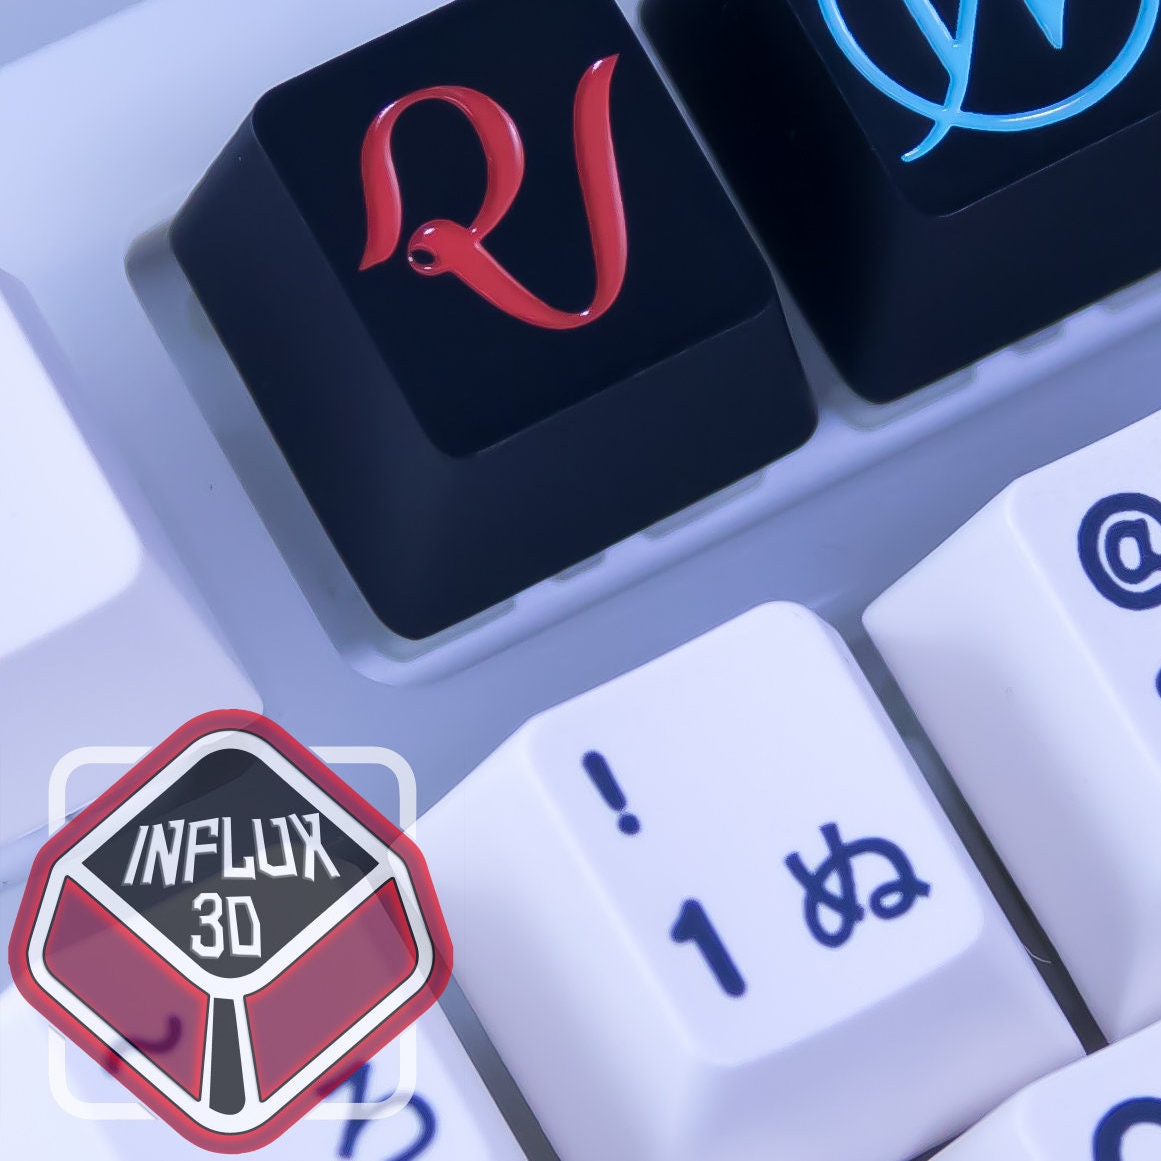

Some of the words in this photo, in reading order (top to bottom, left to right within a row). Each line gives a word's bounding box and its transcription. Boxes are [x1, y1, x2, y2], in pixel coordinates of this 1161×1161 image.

[582, 751, 640, 835] !
[785, 823, 931, 948] ぬ
[671, 899, 746, 997] 1
